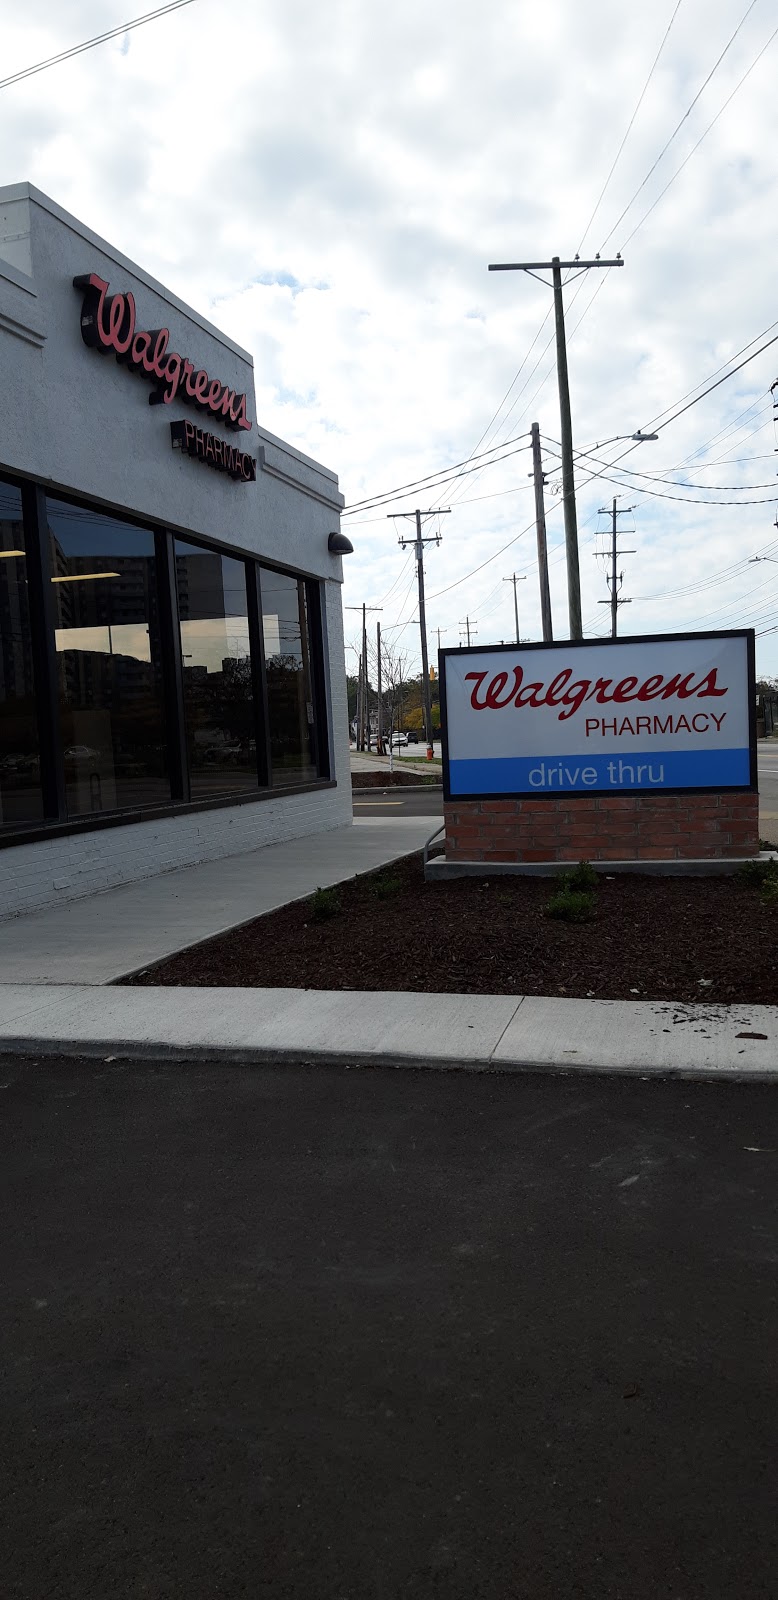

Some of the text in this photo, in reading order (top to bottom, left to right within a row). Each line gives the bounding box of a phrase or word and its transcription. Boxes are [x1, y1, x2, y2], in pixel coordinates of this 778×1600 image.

[89, 273, 252, 431] Walgreens
[184, 420, 257, 480] PHARMACY
[464, 665, 728, 721] Walgreens
[585, 712, 726, 737] PHARMACY
[528, 760, 665, 787] drive thru
